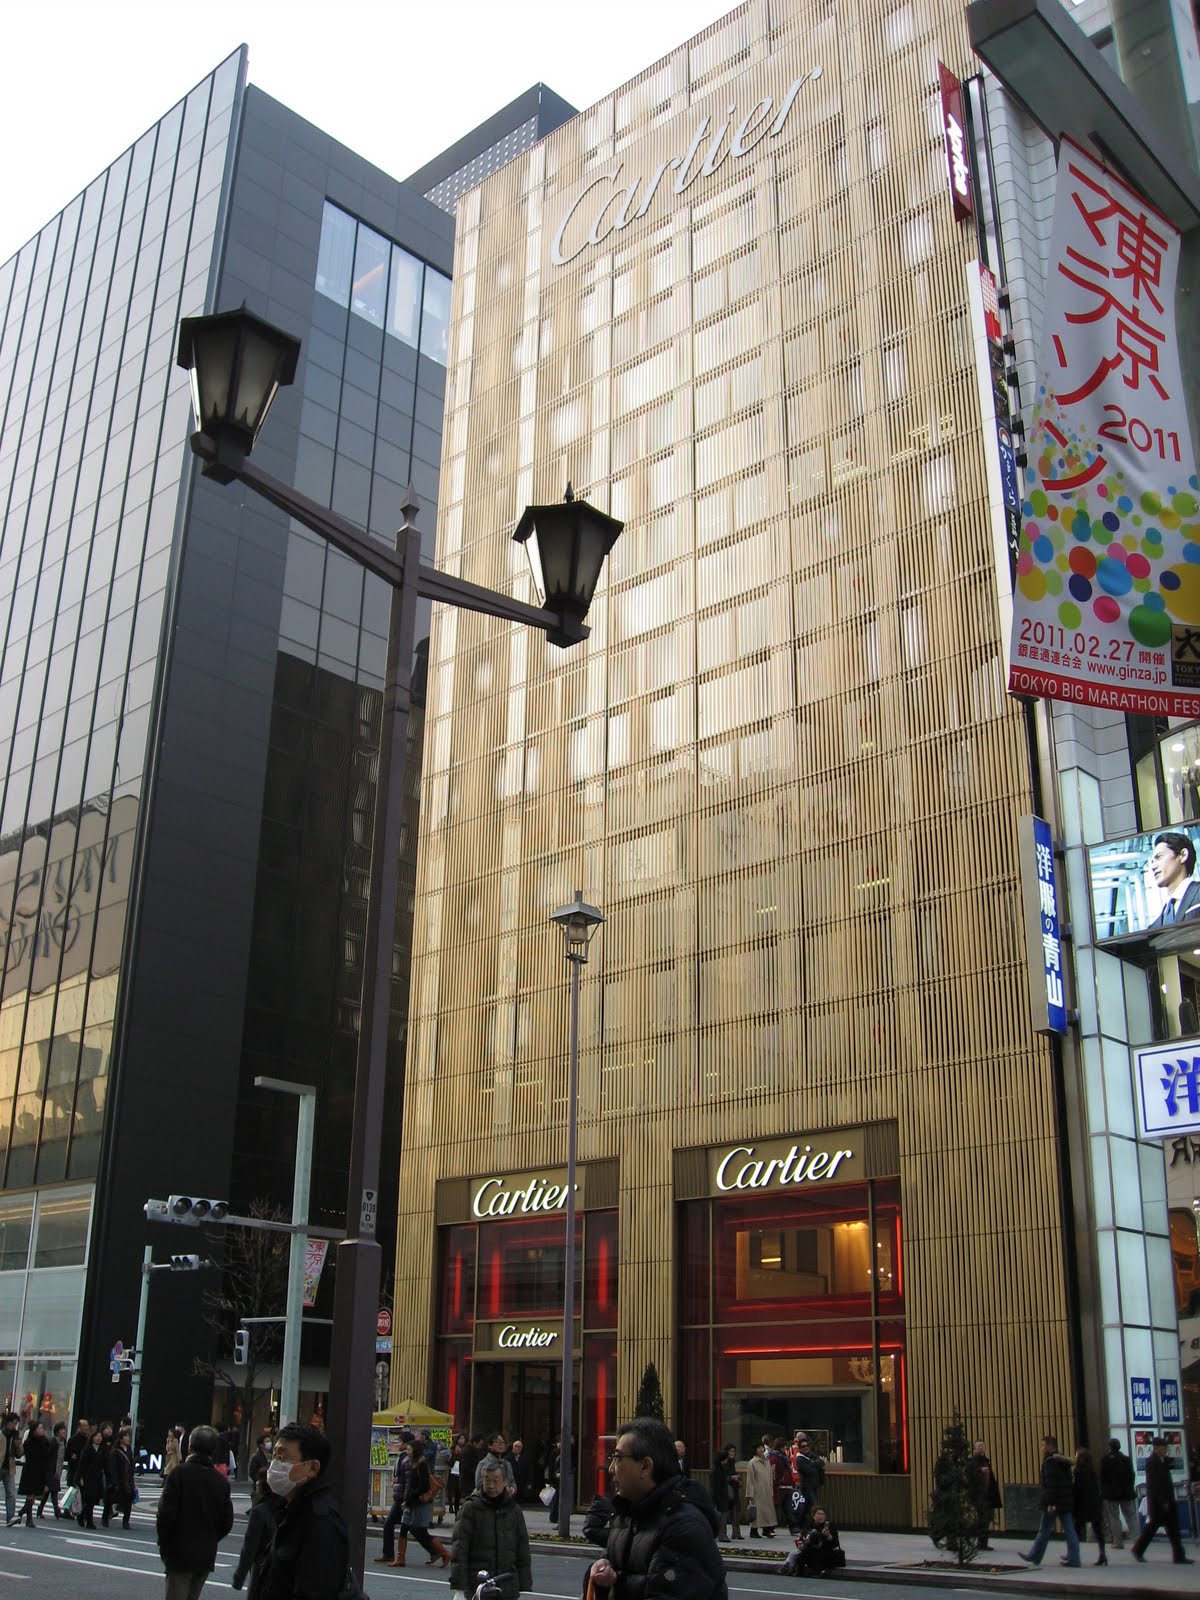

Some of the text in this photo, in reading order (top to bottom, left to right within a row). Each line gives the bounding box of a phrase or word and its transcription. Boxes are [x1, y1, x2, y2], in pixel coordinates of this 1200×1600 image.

[552, 65, 823, 266] Cartier
[1042, 162, 1124, 491] マラソン
[1112, 213, 1170, 401] 東京
[1098, 404, 1181, 462] 2011
[1018, 643, 1081, 670] 銀座通連合会
[1020, 618, 1135, 662] 2011.02.27
[1012, 671, 1057, 695] TOKYO
[1062, 682, 1084, 700] BIG
[1088, 687, 1169, 712] MARATHON
[1087, 661, 1167, 684] www.ginza.jp
[1035, 843, 1063, 1008] 洋服の青山
[716, 1145, 853, 1191] Cartier
[498, 1325, 558, 1348] Cartier
[1134, 1397, 1151, 1417] 青山
